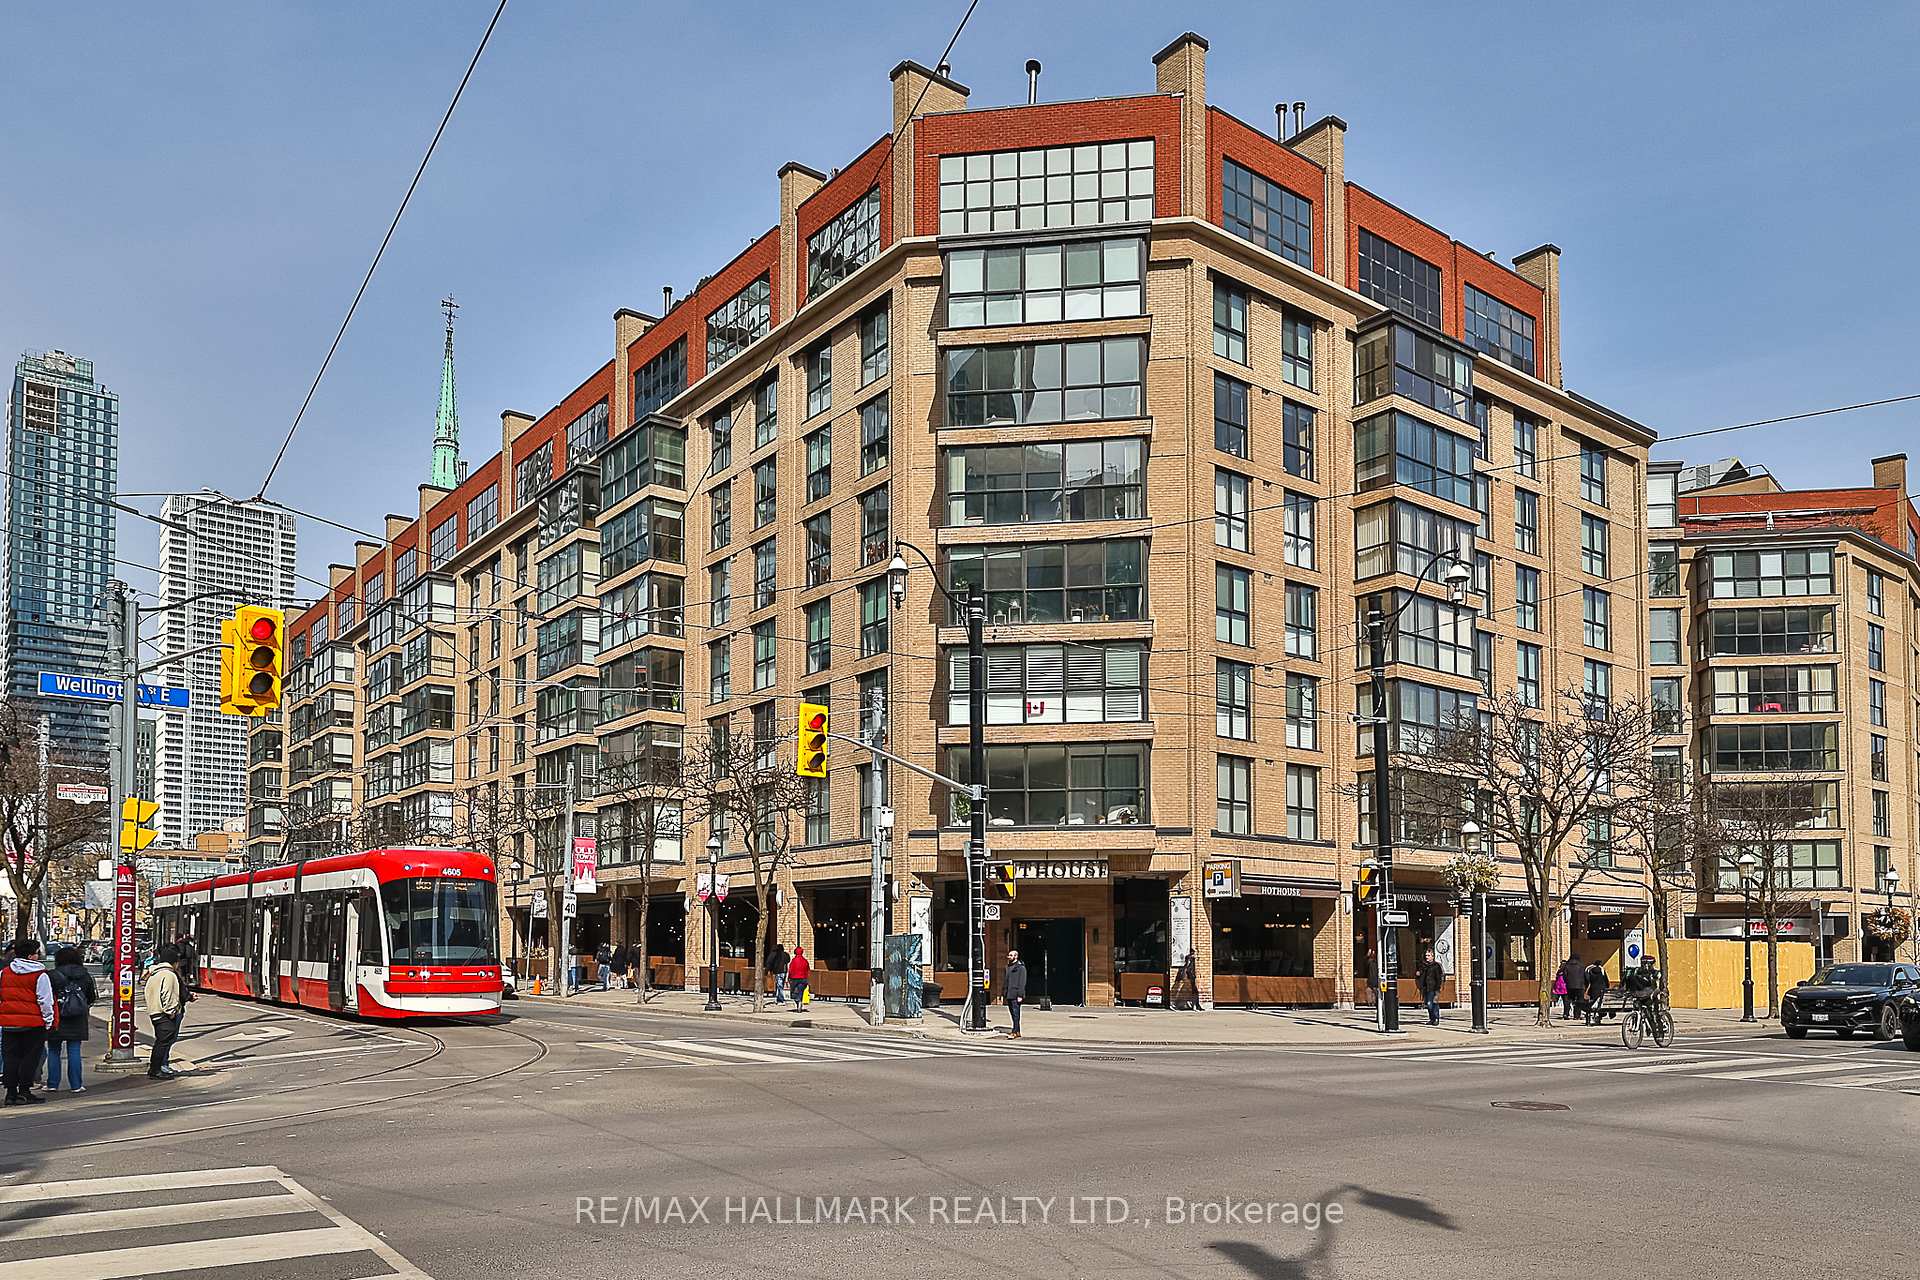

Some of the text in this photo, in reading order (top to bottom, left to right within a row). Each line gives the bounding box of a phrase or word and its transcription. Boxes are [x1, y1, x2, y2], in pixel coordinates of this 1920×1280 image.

[55, 675, 170, 702] Wellingtn St E
[575, 846, 595, 854] OLD
[1206, 862, 1232, 871] PARKING
[442, 867, 462, 877] 4605
[1261, 886, 1301, 896] HOTHOUSE
[564, 903, 576, 914] 40
[120, 901, 133, 961] TORONTO
[118, 1011, 131, 1048] OLD
